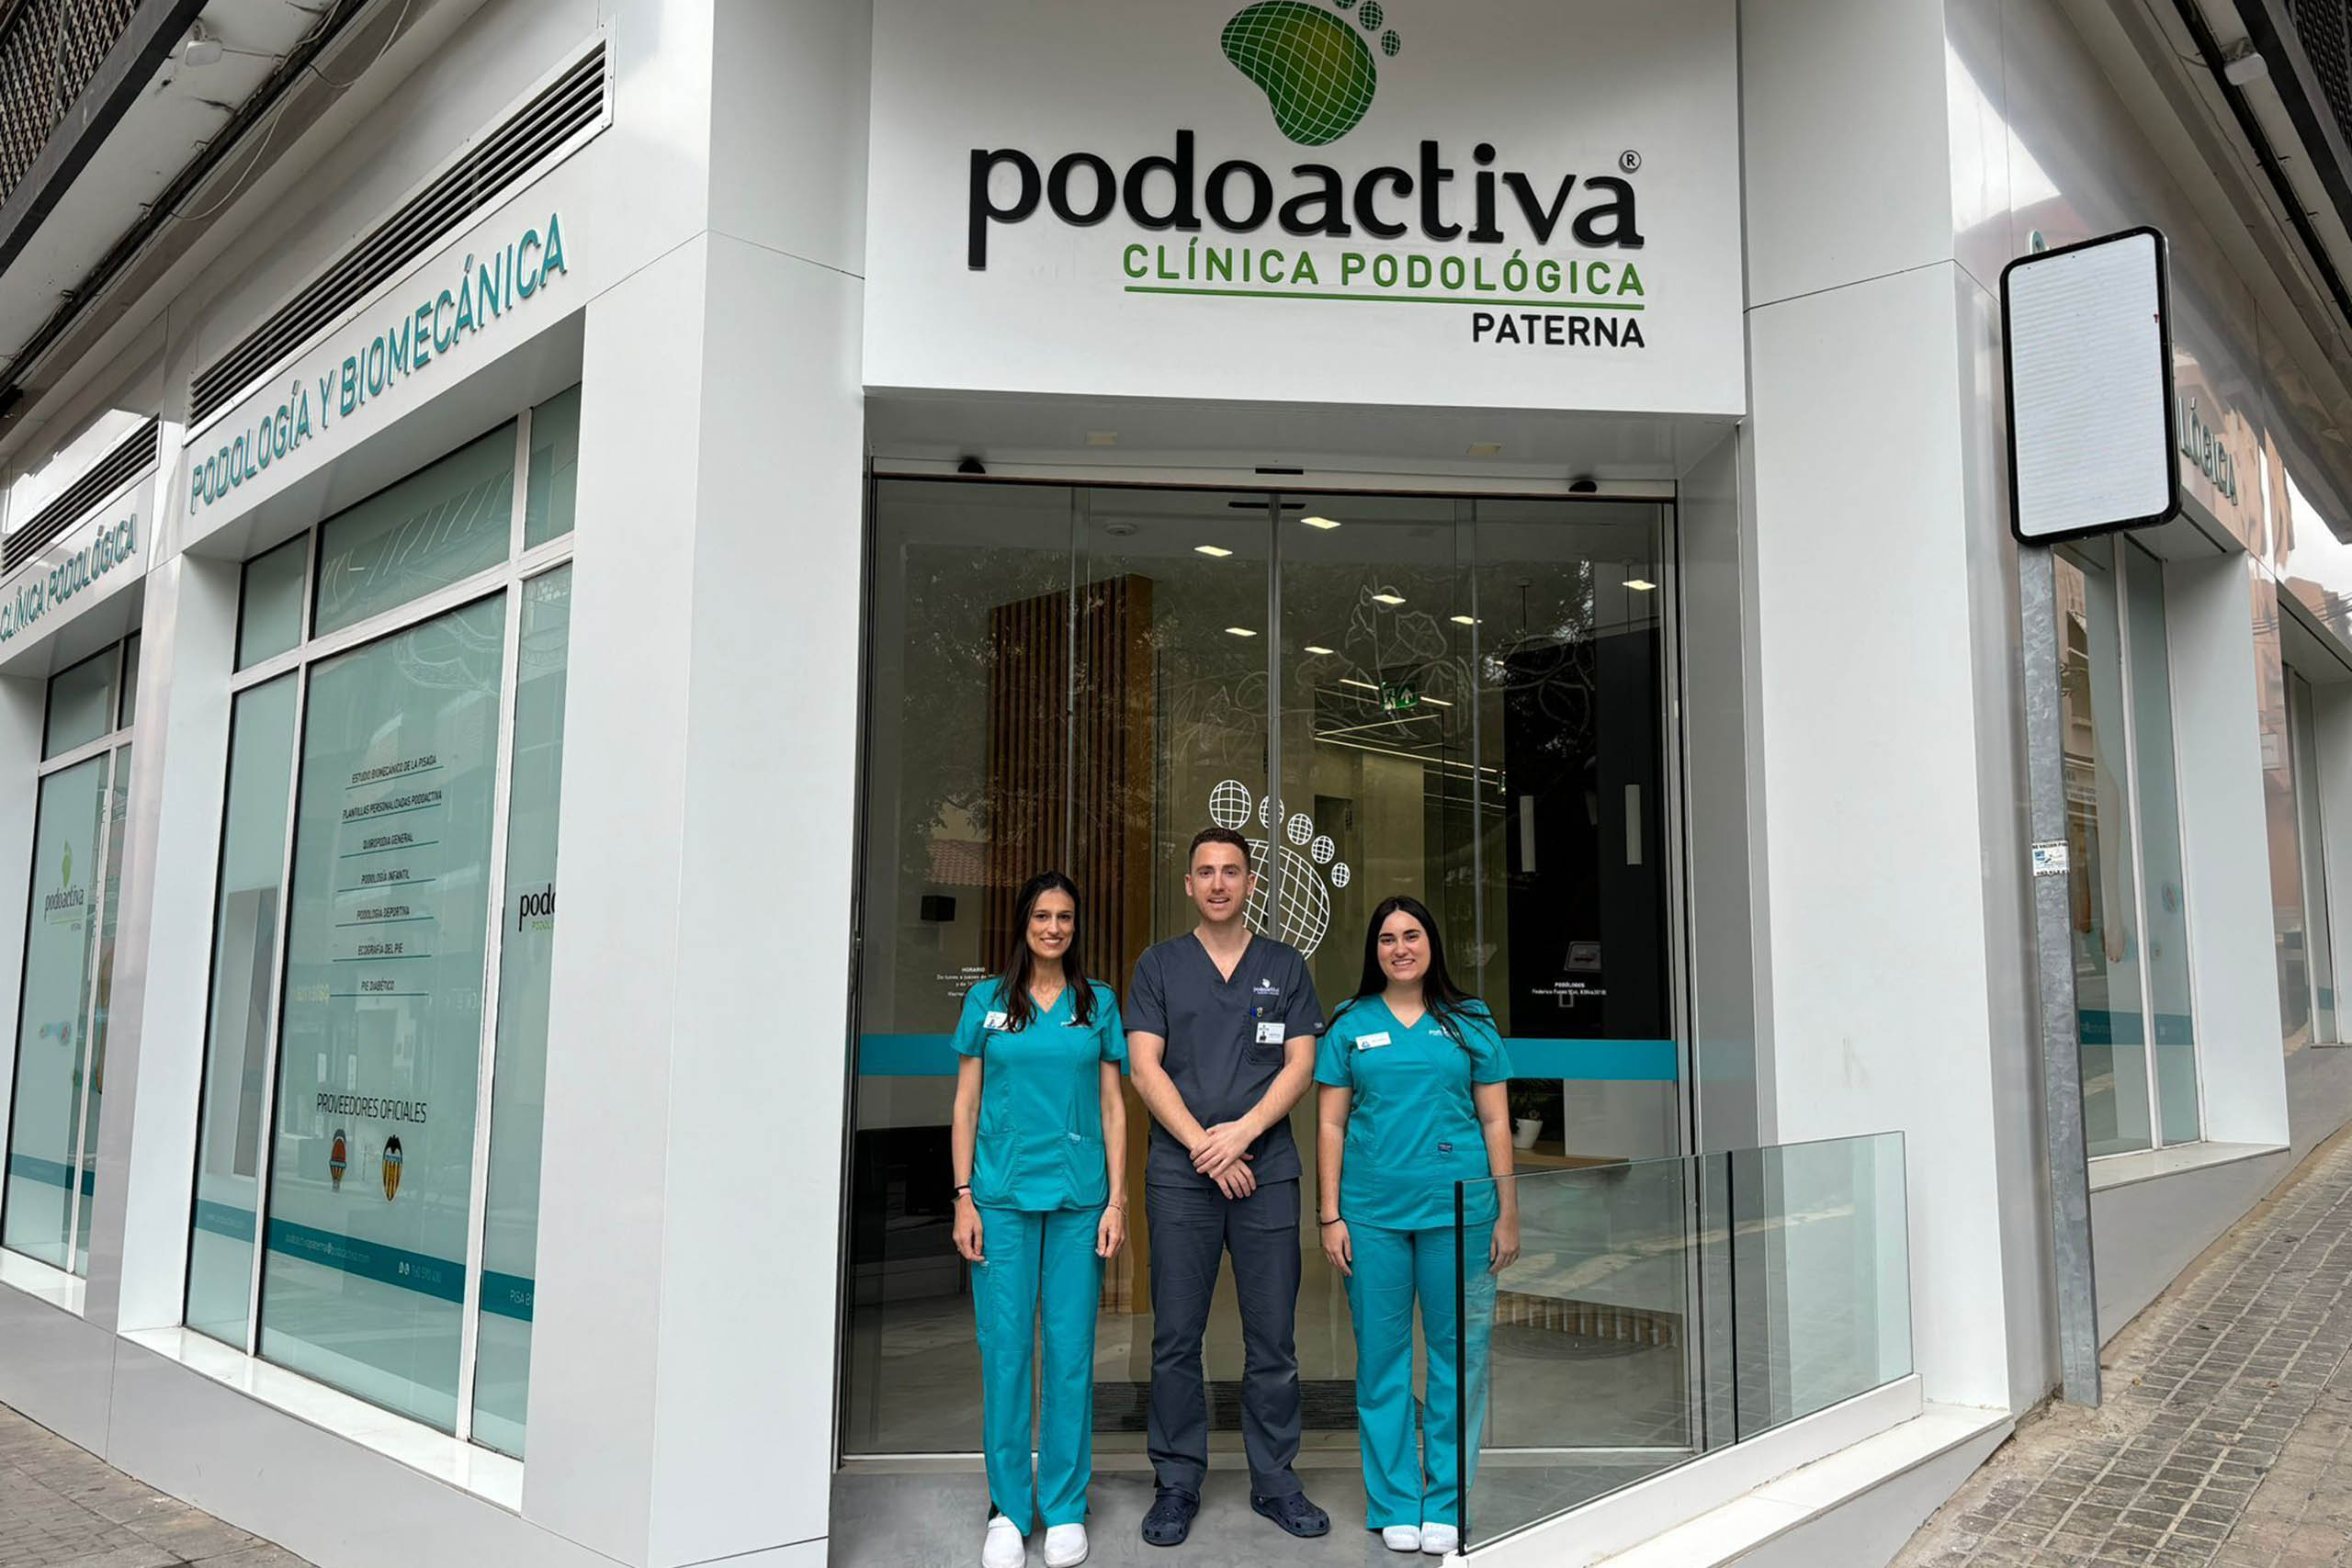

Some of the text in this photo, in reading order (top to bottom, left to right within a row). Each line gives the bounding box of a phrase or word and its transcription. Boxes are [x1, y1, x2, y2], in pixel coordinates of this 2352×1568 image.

[968, 130, 1645, 270] podoactiva
[1123, 236, 1645, 297] CLÍNICA PODOLÓGICA
[1473, 312, 1645, 348] PATERNA
[190, 212, 568, 515] PODOLOGÍA Y BIOMECÁNICA
[0, 513, 137, 642] CLÍNICA PODOLÓGICA
[44, 885, 84, 922] podoactiva
[316, 1093, 427, 1123] PROVEEDORES OFICIALES
